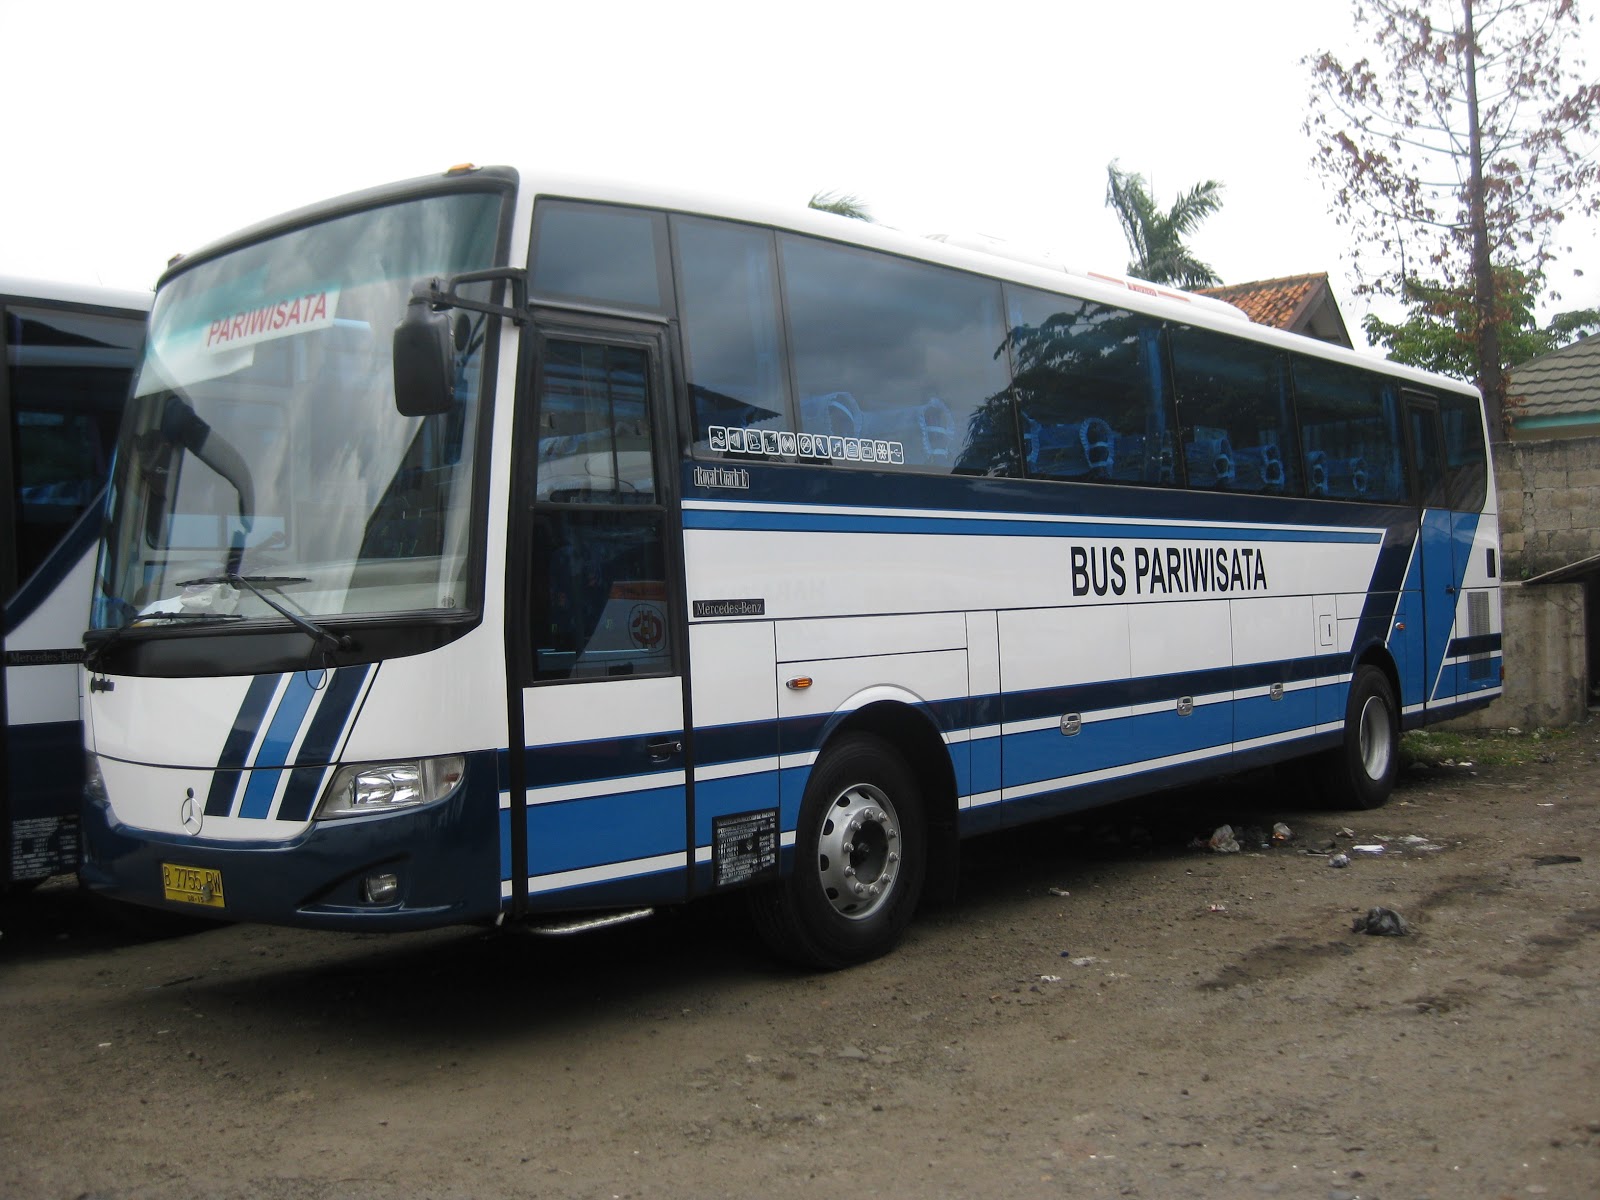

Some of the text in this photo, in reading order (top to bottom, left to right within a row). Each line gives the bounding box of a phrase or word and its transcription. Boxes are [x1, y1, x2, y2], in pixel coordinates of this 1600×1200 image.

[207, 291, 326, 347] PARIWISATA
[697, 466, 717, 488] Royal
[1071, 546, 1267, 596] BUS PARIWISATA
[696, 601, 762, 615] Mercedes-Benz
[164, 866, 171, 885] B
[175, 867, 202, 890] 7755
